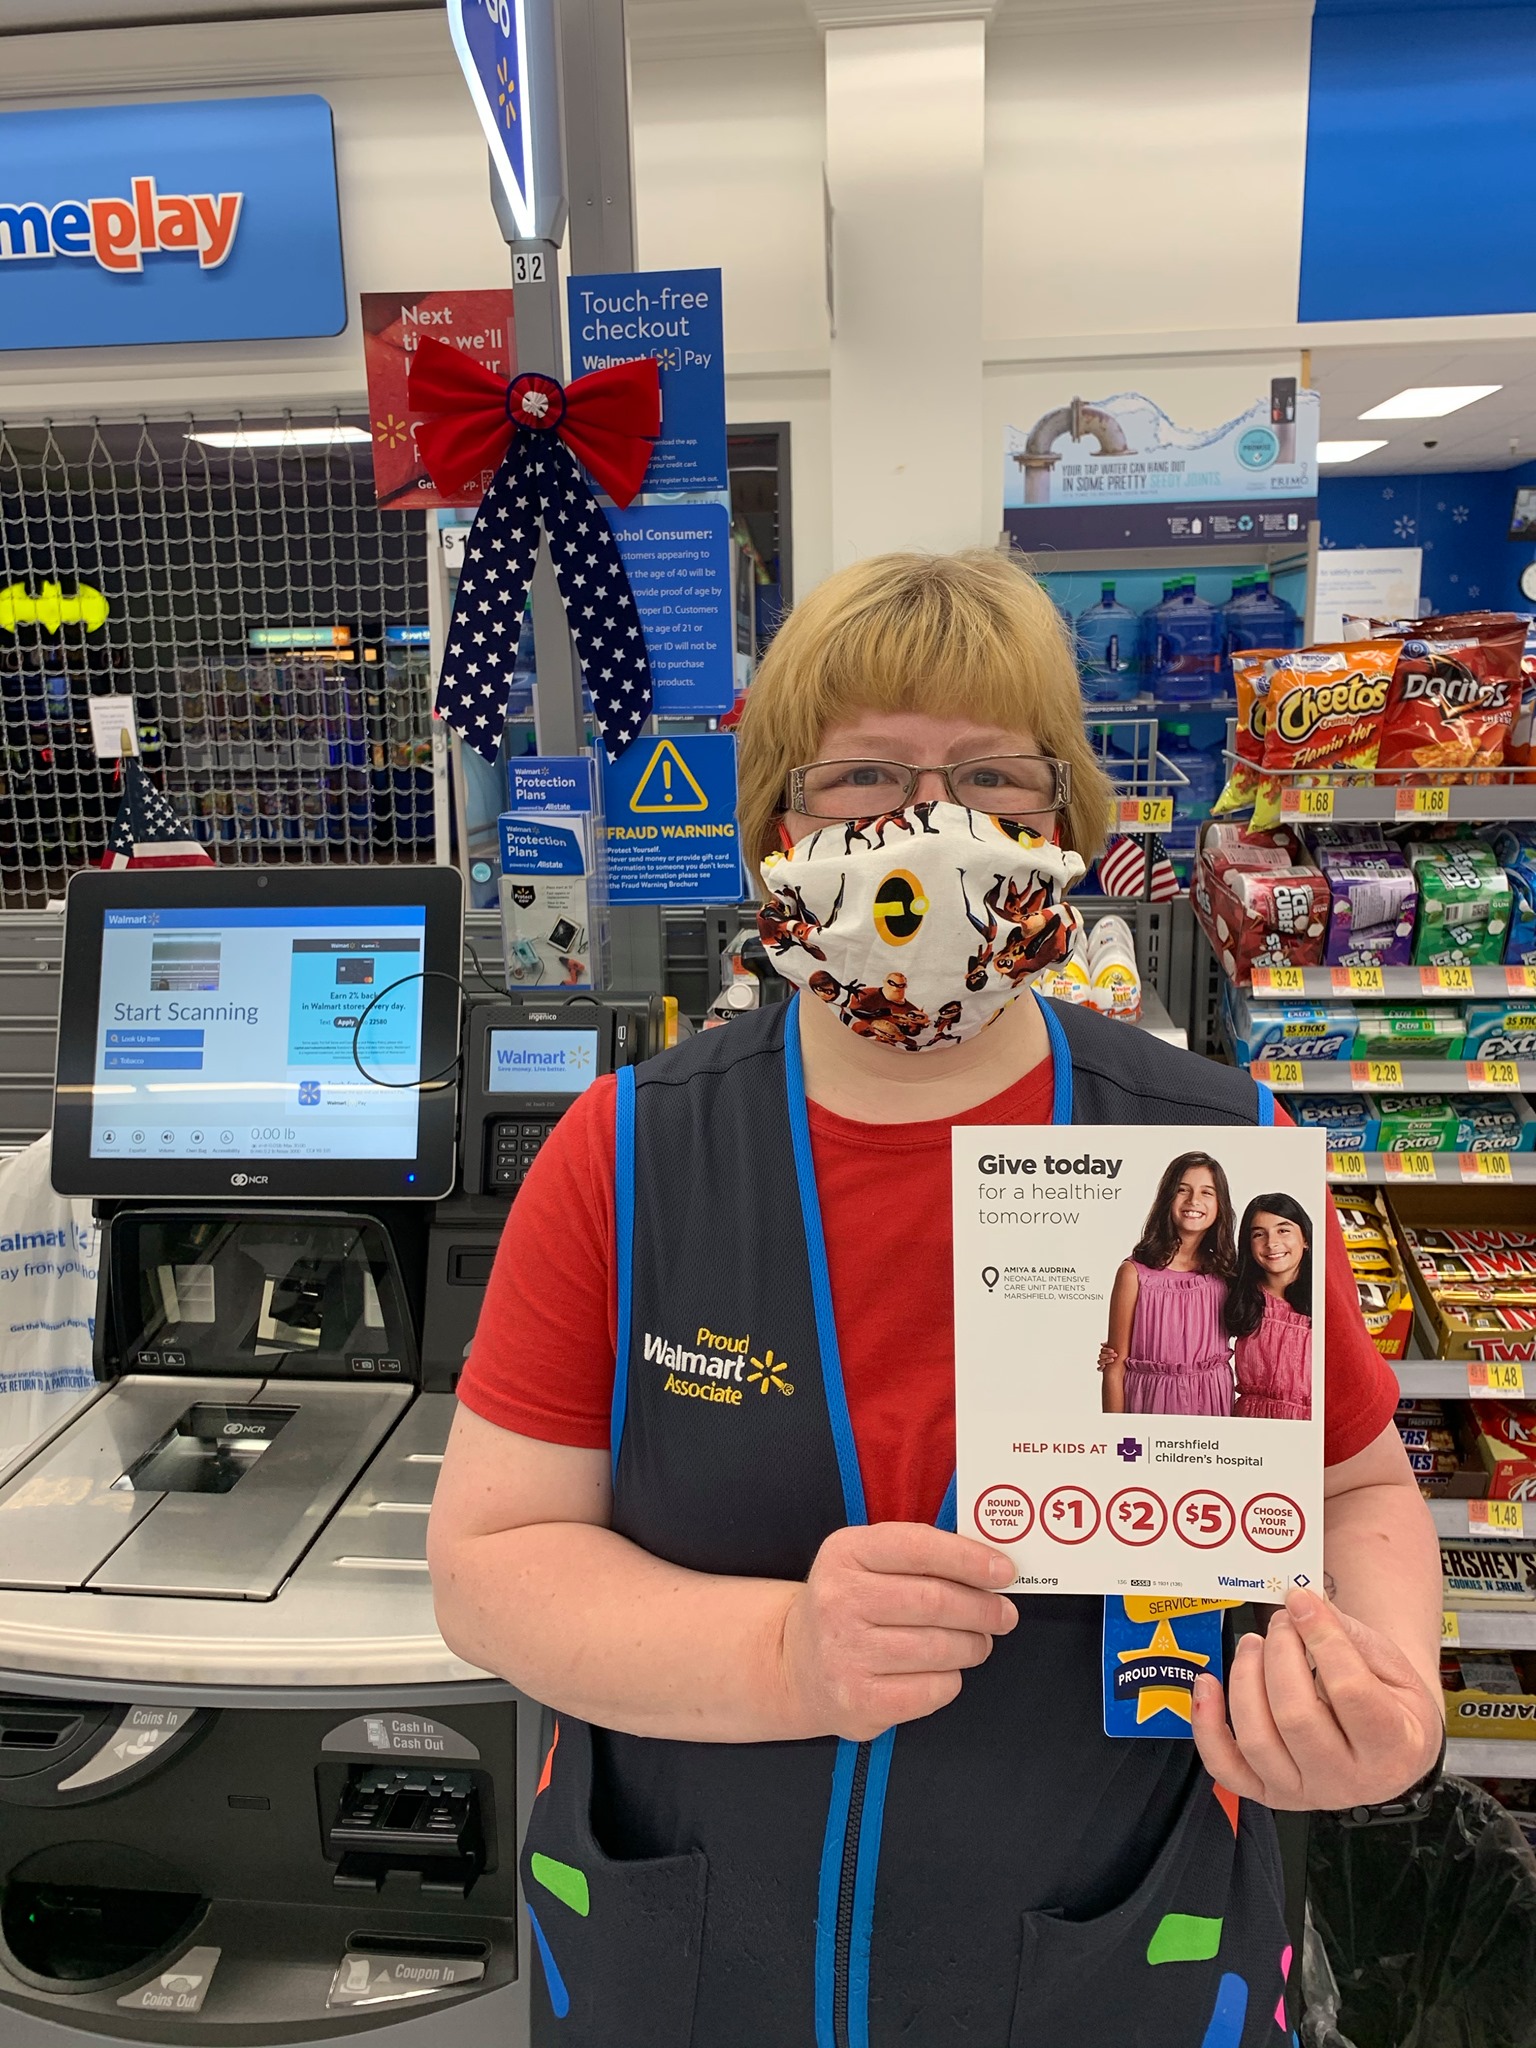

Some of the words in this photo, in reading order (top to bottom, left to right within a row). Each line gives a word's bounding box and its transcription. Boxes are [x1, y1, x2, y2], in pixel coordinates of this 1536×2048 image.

[515, 255, 542, 281] 32
[580, 287, 709, 314] Touch-free
[401, 306, 453, 325] Next
[582, 316, 690, 341] checkout
[684, 350, 712, 369] Pay
[1101, 462, 1128, 475] WATER
[1129, 462, 1146, 474] CAN
[1062, 478, 1073, 492] IN
[1076, 476, 1103, 491] SOME
[1107, 475, 1147, 490] PRETTY
[646, 529, 713, 542] Consumer:
[657, 551, 699, 561] appearing
[700, 551, 710, 559] to
[634, 569, 648, 578] the
[650, 570, 665, 580] age
[667, 568, 676, 577] of
[677, 569, 688, 577] 40
[689, 568, 704, 576] will
[705, 568, 716, 577] be
[661, 587, 684, 598] proof
[685, 587, 694, 596] of
[695, 588, 710, 598] age
[711, 587, 722, 597] by
[675, 605, 718, 615] Customers
[655, 624, 671, 634] age
[672, 624, 682, 633] of
[682, 624, 692, 632] 21
[694, 625, 703, 633] or
[664, 642, 673, 650] ID
[675, 642, 689, 651] will
[690, 642, 705, 651] not
[706, 642, 717, 651] be
[658, 661, 666, 669] to
[668, 660, 705, 671] purchase
[658, 678, 695, 689] products.
[1403, 674, 1509, 707] Doritos
[1280, 674, 1389, 742] Cheetos
[1348, 722, 1376, 744] Hot
[514, 768, 541, 776] Walmart
[515, 777, 576, 788] Protection
[516, 789, 546, 800] Plans
[607, 827, 658, 840] FRAUD
[661, 824, 735, 839] WARNING
[507, 833, 567, 847] Protection
[508, 846, 538, 858] Plans
[607, 846, 631, 854] Protect
[537, 861, 563, 869] Allstate
[628, 855, 644, 863] send
[645, 855, 666, 864] money
[676, 854, 700, 863] provide
[702, 853, 714, 862] gift
[714, 853, 730, 861] card
[655, 863, 685, 871] someone
[686, 864, 698, 872] you
[639, 872, 677, 880] information
[678, 872, 698, 880] please
[109, 915, 147, 924] Walmart
[114, 1003, 161, 1021] Start
[168, 1002, 259, 1025] Scanning
[528, 1013, 557, 1022] ingenico
[337, 1019, 355, 1027] Apply
[1506, 1017, 1517, 1026] 35
[1286, 1025, 1297, 1033] 35
[1299, 1024, 1326, 1033] STICKS
[497, 1050, 566, 1065] Walmart
[1381, 1095, 1442, 1114] Extra
[1302, 1104, 1364, 1121] Extra
[251, 1127, 281, 1140] 0.00
[284, 1127, 296, 1140] lb
[1394, 1136, 1440, 1152] Extra
[1472, 1136, 1518, 1152] Extra
[978, 1154, 1037, 1175] Give
[1044, 1154, 1123, 1179] today
[248, 1176, 269, 1184] NCR
[978, 1183, 1006, 1200] for
[1013, 1187, 1024, 1200] a
[1032, 1183, 1122, 1200] healthier
[979, 1209, 1080, 1225] tomorrow
[1004, 1293, 1056, 1301] MARSHFIELD,
[1058, 1293, 1104, 1301] WISCONSIN
[696, 1327, 750, 1355] Proud
[643, 1332, 746, 1382] Walmart
[664, 1373, 743, 1406] Associate
[1012, 1443, 1048, 1453] HELP
[1053, 1443, 1085, 1454] KIDS
[1090, 1444, 1108, 1454] AT
[1155, 1439, 1219, 1450] marshfield
[1155, 1453, 1212, 1464] children's
[1216, 1455, 1263, 1467] hospital
[987, 1499, 1021, 1507] ROUND
[985, 1509, 998, 1517] UP
[998, 1509, 1024, 1517] YOUR
[1052, 1499, 1083, 1529] $1
[1118, 1501, 1155, 1531] $2
[1185, 1503, 1223, 1534] $5
[1253, 1507, 1293, 1517] CHOOSE
[990, 1518, 1018, 1527] TOTAL
[1259, 1517, 1287, 1527] YOUR
[1251, 1526, 1295, 1537] AMOUNT
[1217, 1576, 1265, 1589] Walmart
[1448, 1578, 1483, 1590] COOKIES
[1496, 1581, 1525, 1592] CREME
[1149, 1597, 1198, 1615] SERVICE
[1118, 1666, 1157, 1686] PROUD
[1159, 1666, 1198, 1683] VETER
[1460, 1702, 1536, 1719] ARIBO
[133, 1710, 164, 1725] Coins
[166, 1711, 178, 1725] In
[392, 1720, 420, 1733] Cash
[423, 1722, 434, 1734] In
[393, 1736, 421, 1749] Cash
[424, 1738, 444, 1751] Out
[395, 1963, 440, 1982] Coupon
[442, 1966, 455, 1981] In
[142, 1992, 173, 2007] Coins
[176, 1993, 198, 2008] Out
